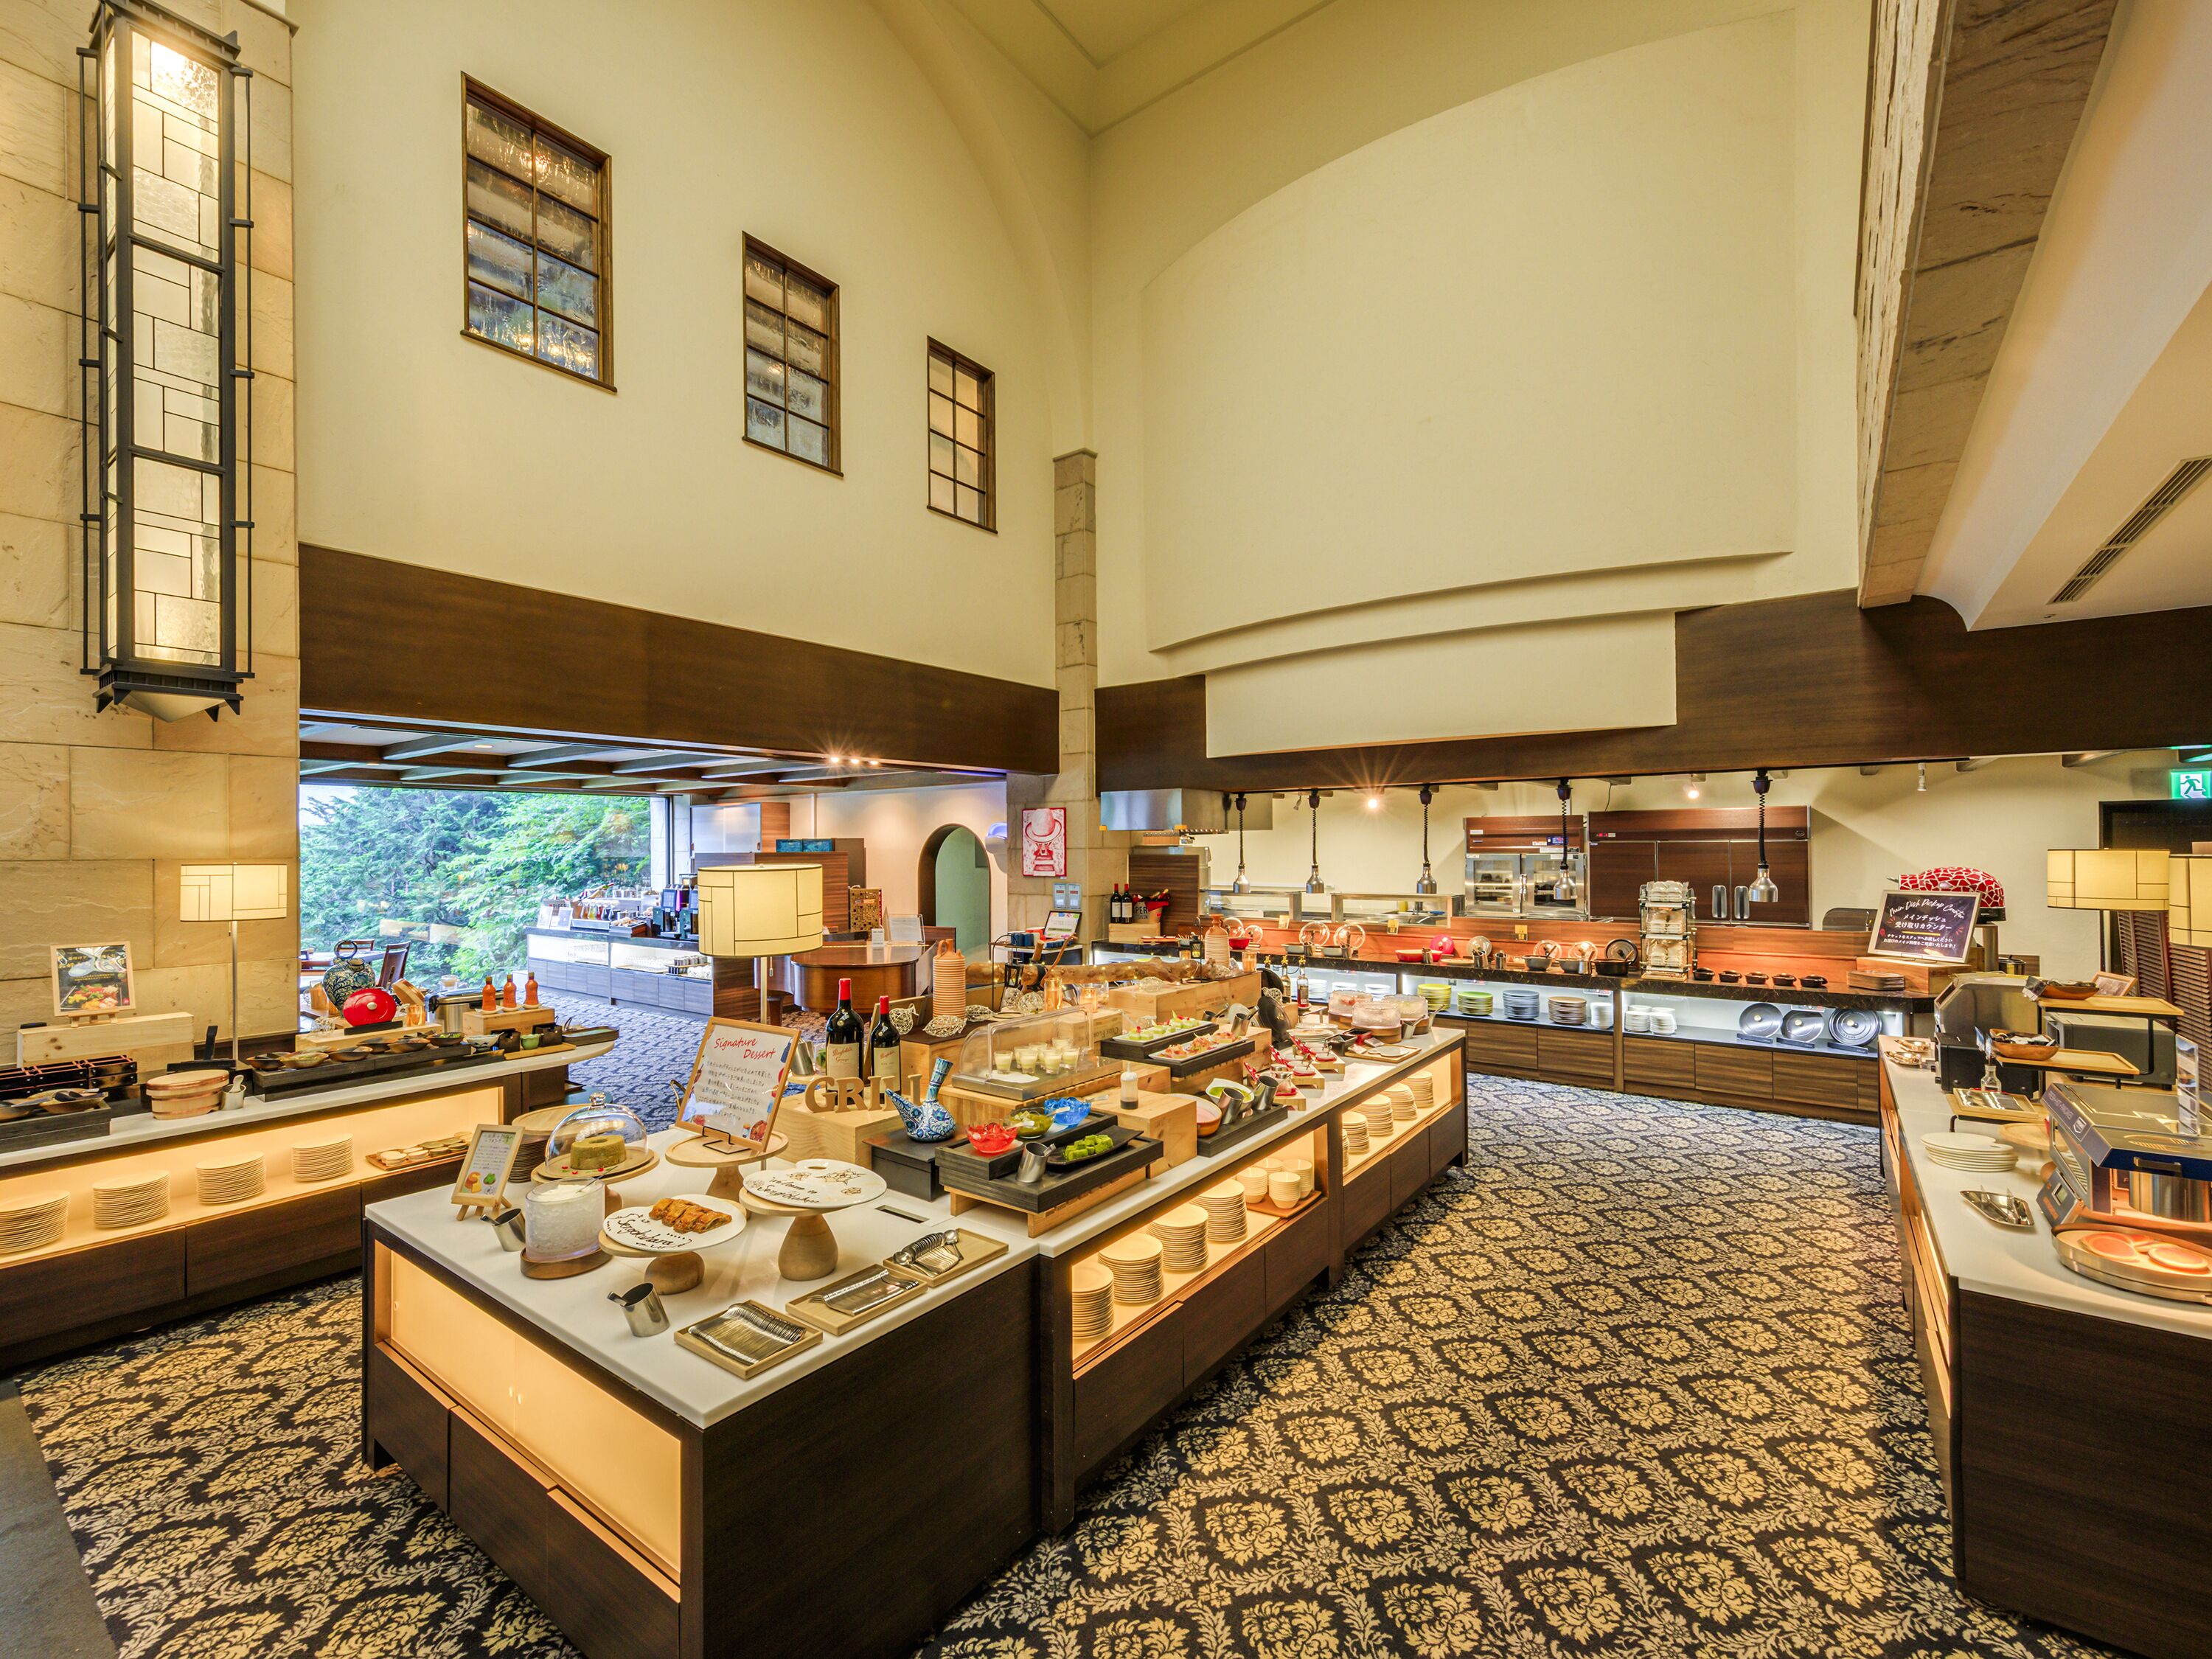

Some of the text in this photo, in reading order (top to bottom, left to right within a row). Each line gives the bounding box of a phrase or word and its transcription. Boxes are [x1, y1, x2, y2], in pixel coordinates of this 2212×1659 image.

[1889, 906, 1905, 917] Main
[1905, 899, 1921, 911] Dish
[1921, 898, 1944, 908] Pickup
[1894, 921, 1952, 931] 受け取りカウンター
[714, 1037, 758, 1051] Signature
[742, 1048, 776, 1060] Dessert
